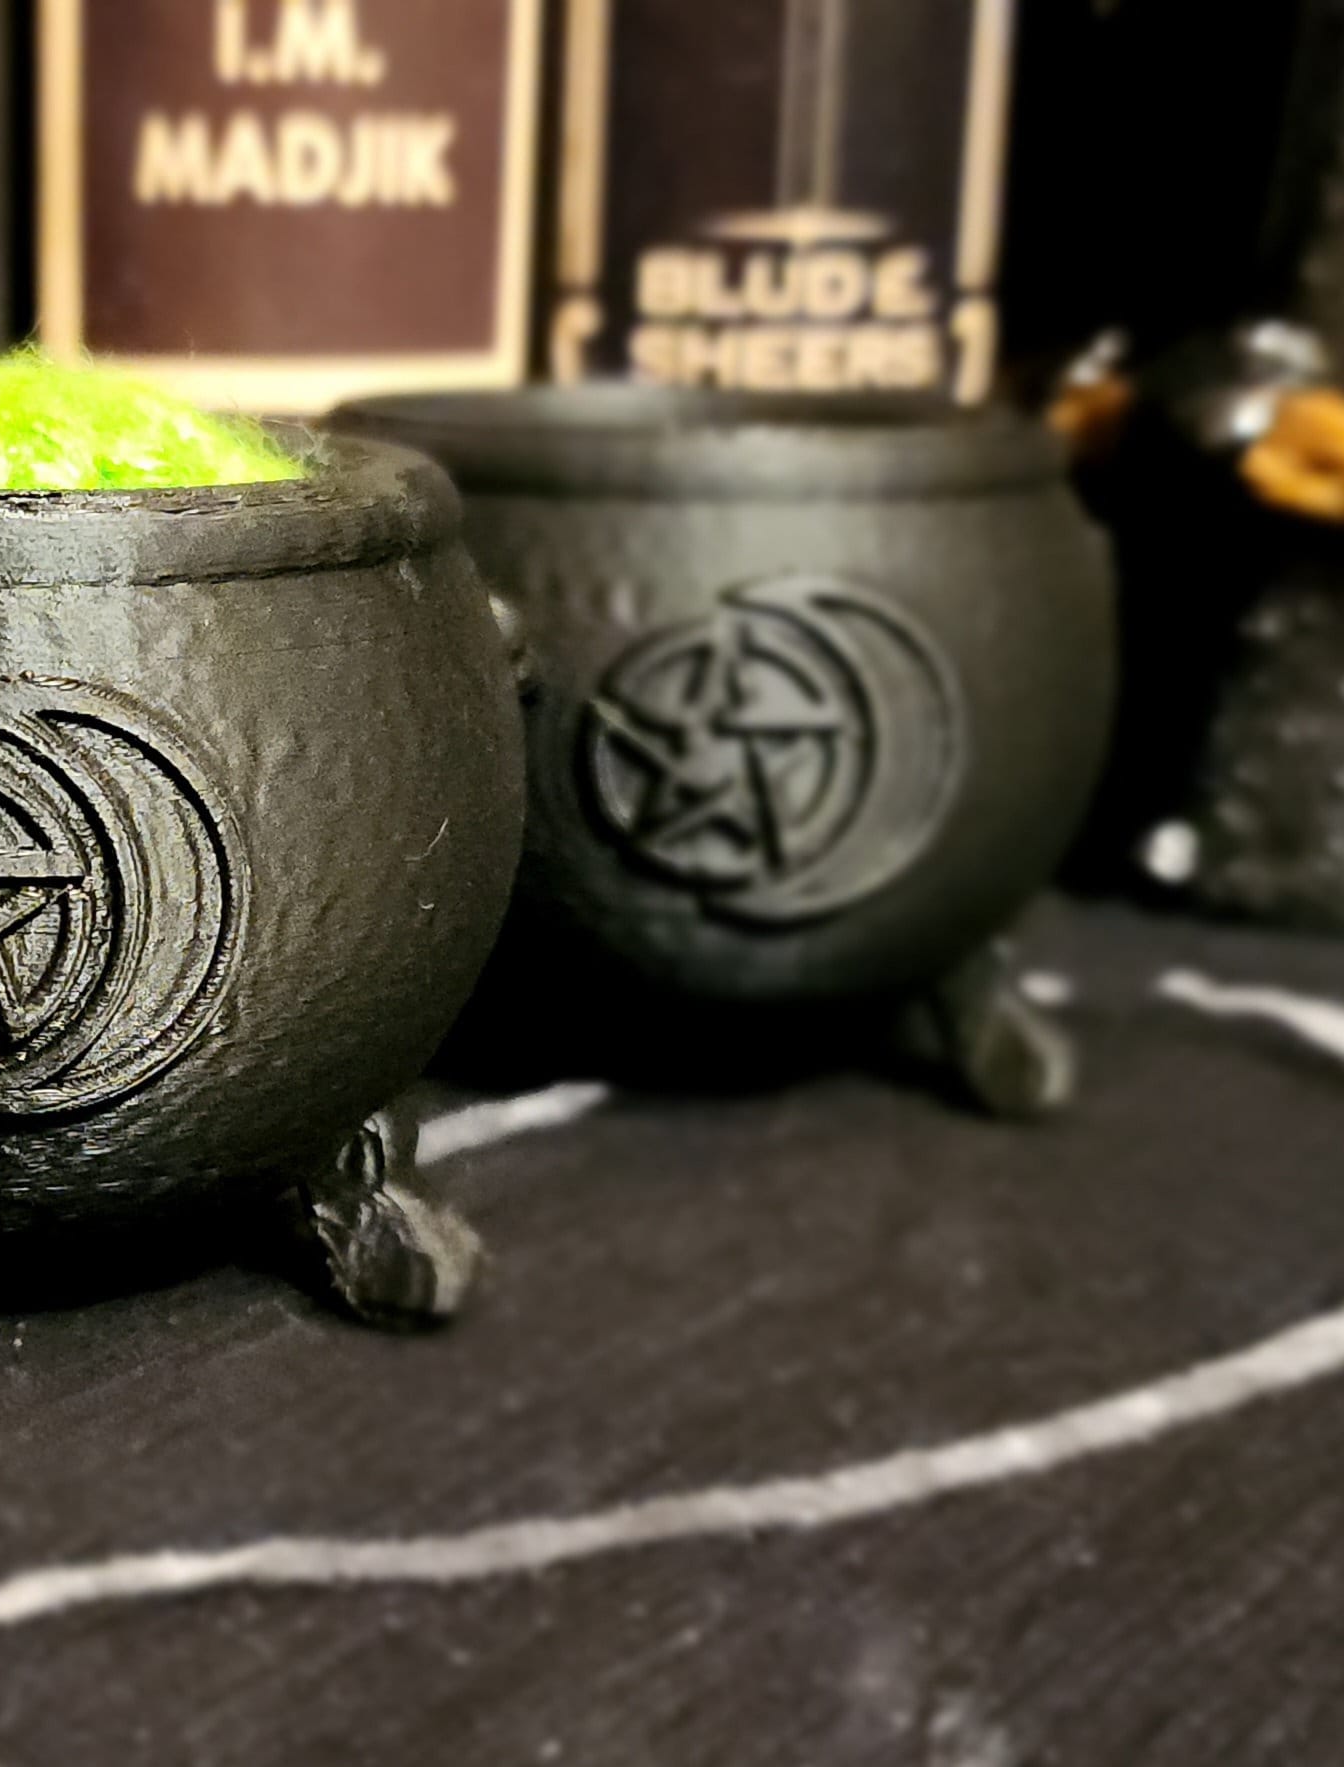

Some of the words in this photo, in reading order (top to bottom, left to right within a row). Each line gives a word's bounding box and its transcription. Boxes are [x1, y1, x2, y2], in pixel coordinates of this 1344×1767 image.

[214, 0, 382, 84] I.M.
[134, 112, 455, 205] MADJIK
[637, 247, 866, 316] BLUD
